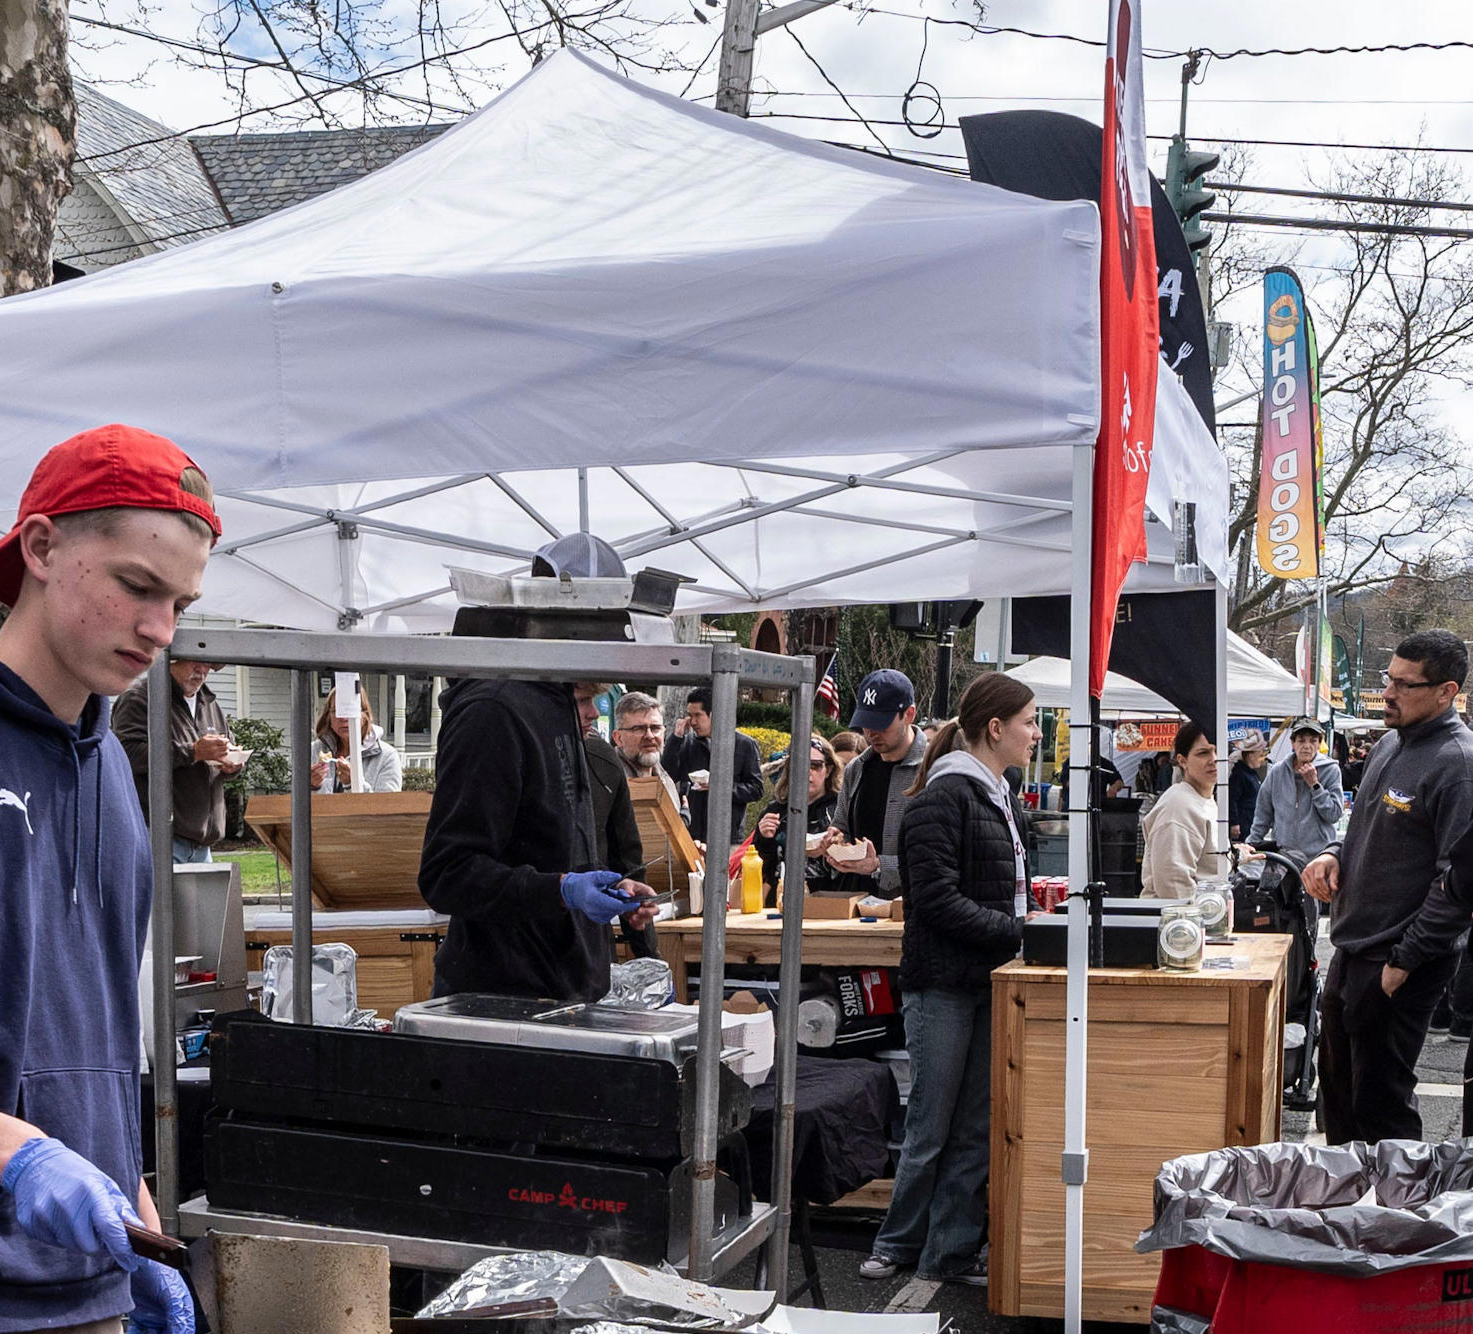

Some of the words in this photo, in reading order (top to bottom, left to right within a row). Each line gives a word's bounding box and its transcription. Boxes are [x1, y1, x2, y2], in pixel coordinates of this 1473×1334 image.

[838, 975, 859, 1017] FORKS
[508, 1188, 556, 1205] CAMP
[581, 1197, 628, 1214] CHEF
